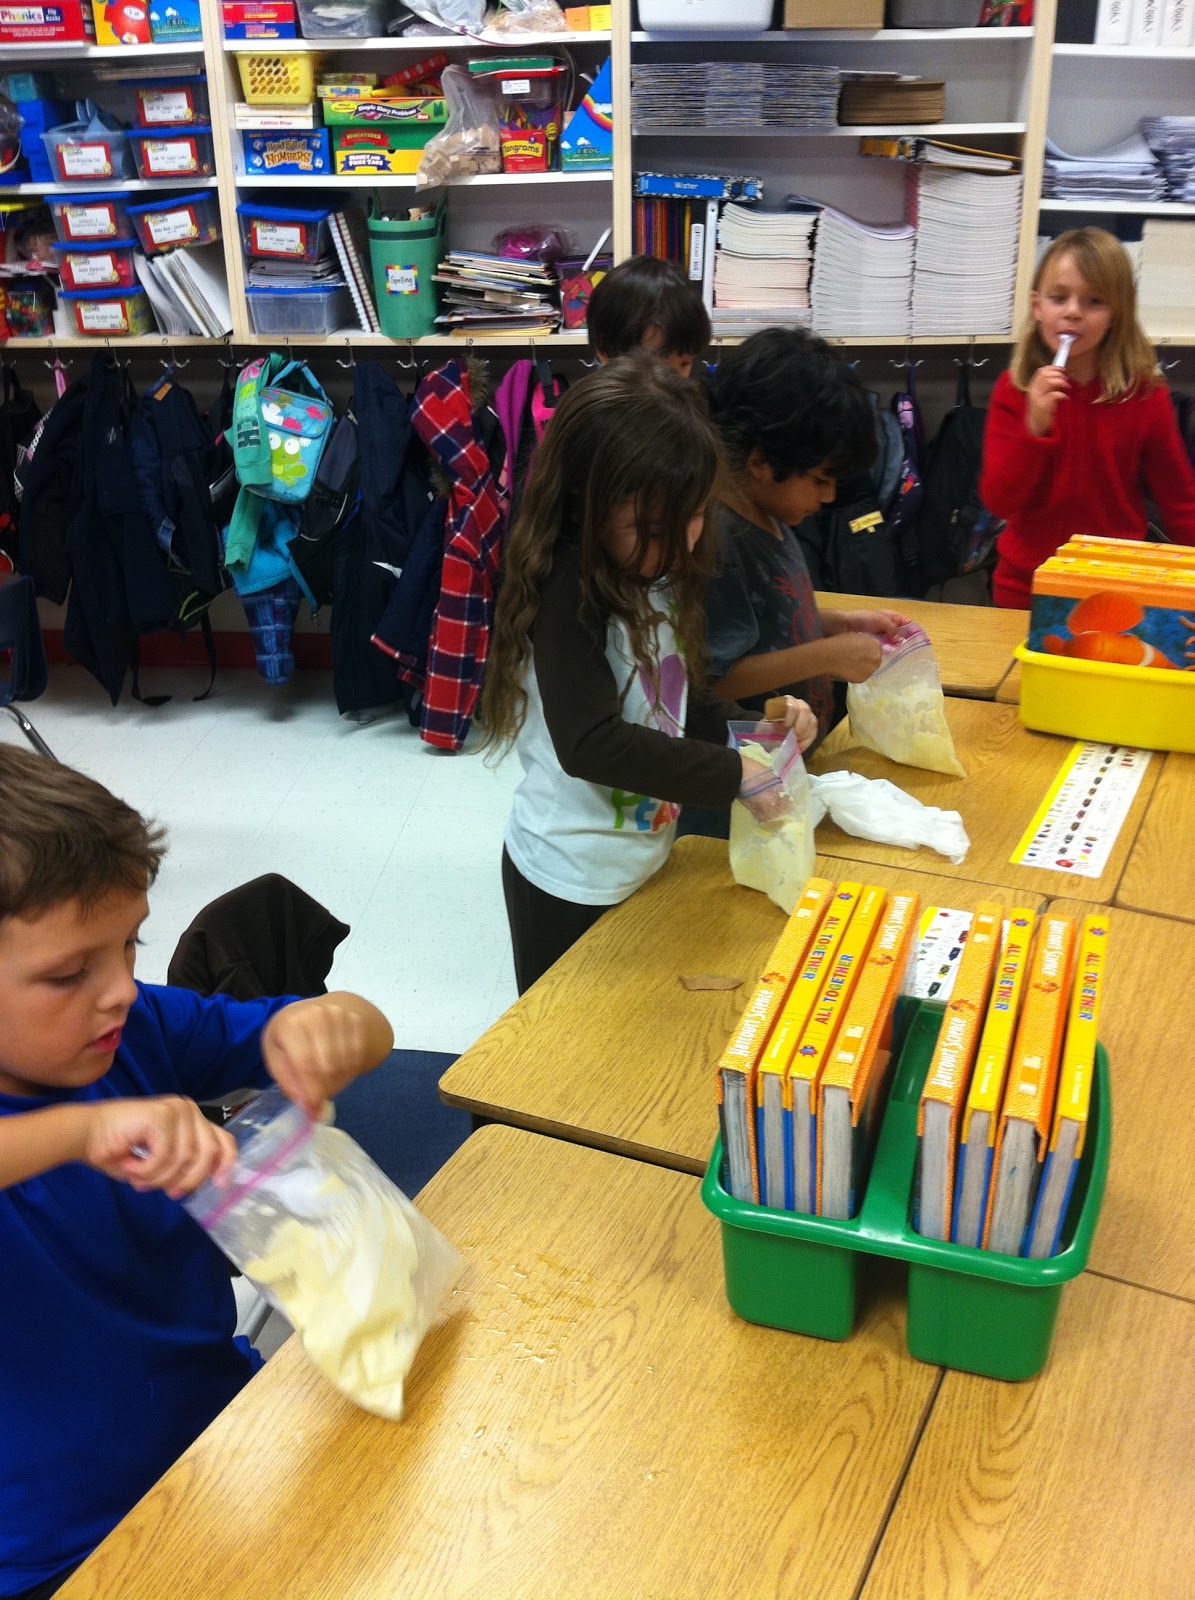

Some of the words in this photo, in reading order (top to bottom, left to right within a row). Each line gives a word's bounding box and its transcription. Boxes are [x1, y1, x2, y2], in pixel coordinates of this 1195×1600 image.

[266, 151, 312, 167] NUMBERS
[391, 275, 413, 286] Spelling
[824, 915, 840, 931] ALL
[802, 934, 832, 981] TOGETHER
[1007, 943, 1021, 959] ALL
[1085, 952, 1101, 968] ALL
[822, 954, 854, 1003] TOGETHER
[994, 962, 1018, 1012] TOGETHER
[1078, 972, 1099, 1021] TOGETHER
[728, 1012, 758, 1057] Harcourt
[750, 988, 774, 1022] Science
[815, 1006, 833, 1025] ALL
[942, 1016, 967, 1051] Science
[931, 1046, 959, 1089] Harcourt
